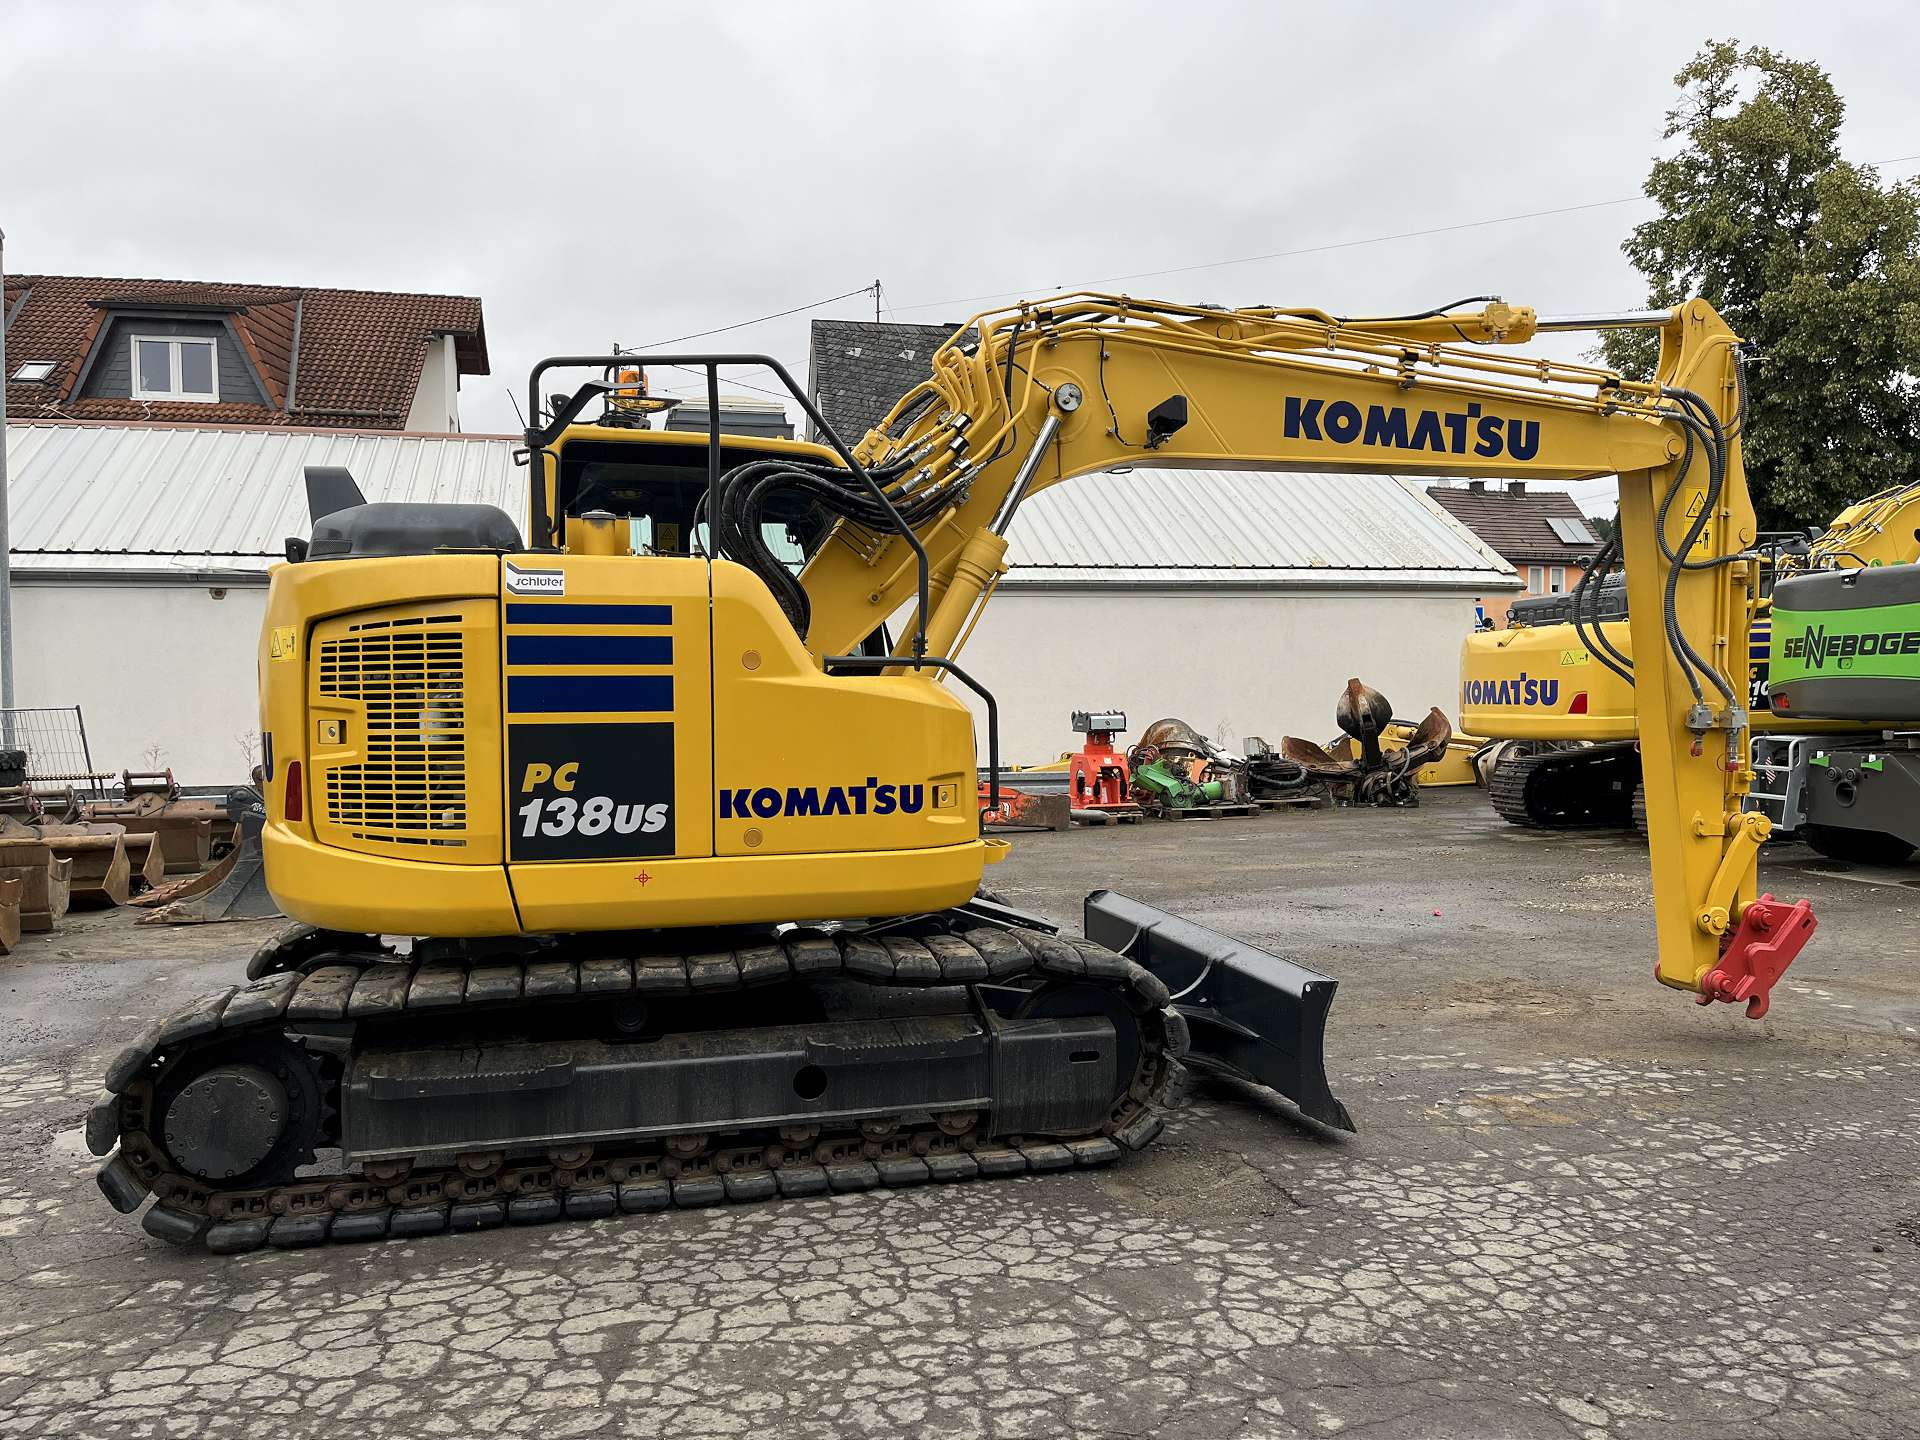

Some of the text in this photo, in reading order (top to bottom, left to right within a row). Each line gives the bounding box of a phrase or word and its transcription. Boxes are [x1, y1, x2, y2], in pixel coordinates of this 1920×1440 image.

[1283, 396, 1541, 461] KOMATSU
[1463, 672, 1559, 706] KOMATSU
[521, 761, 580, 793] PC
[719, 776, 924, 819] KOMATSU
